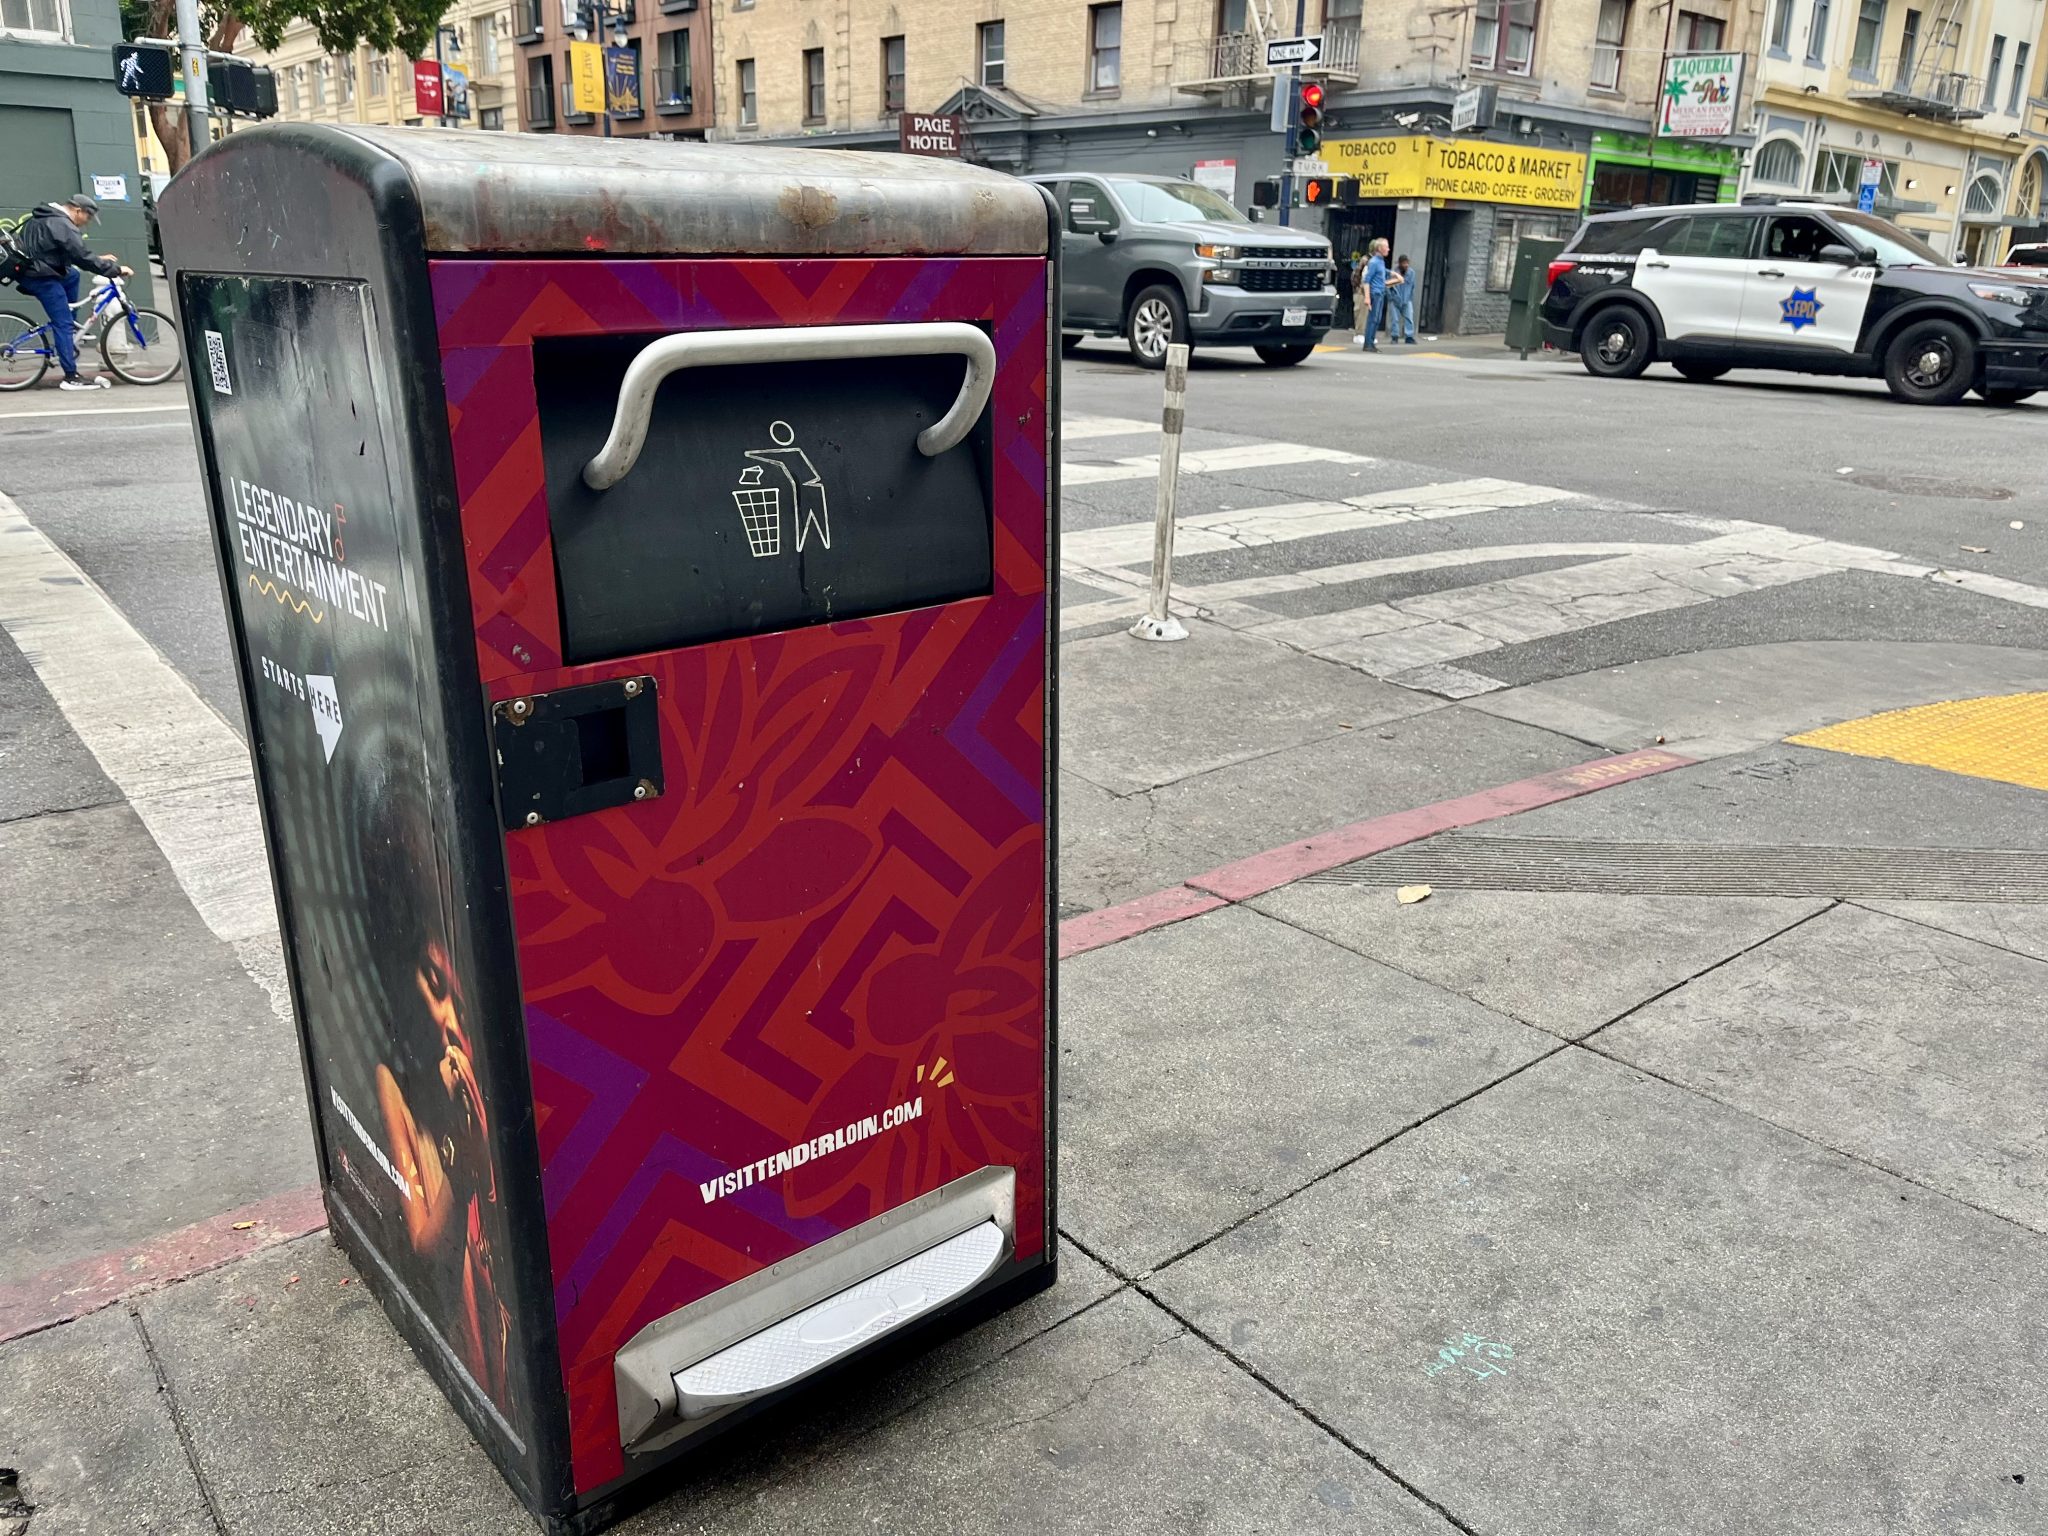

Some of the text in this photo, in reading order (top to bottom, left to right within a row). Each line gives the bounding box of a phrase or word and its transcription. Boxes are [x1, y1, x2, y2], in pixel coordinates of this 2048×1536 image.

[1271, 45, 1306, 60] ONE WAY
[582, 50, 596, 105] UC Law
[1672, 57, 1734, 79] TAQUERIA
[1672, 105, 1732, 114] MEXICAN FOOD
[913, 117, 952, 133] PAGE
[909, 134, 957, 150] HOTEL
[1339, 141, 1397, 157] TOBACCO
[1298, 161, 1325, 173] TURK
[1362, 159, 1369, 170] &
[1440, 149, 1572, 180] TOBACCO & MARKET
[1352, 172, 1389, 186] RKET
[1425, 176, 1576, 203] PHONE CARD COFFEE GROCERY
[230, 476, 334, 558] LEGENDARY
[238, 521, 388, 633] ENTERTAINMENT
[261, 656, 341, 725] STARTS HERE
[700, 1096, 922, 1204] VISITTENDERLOIN.COM
